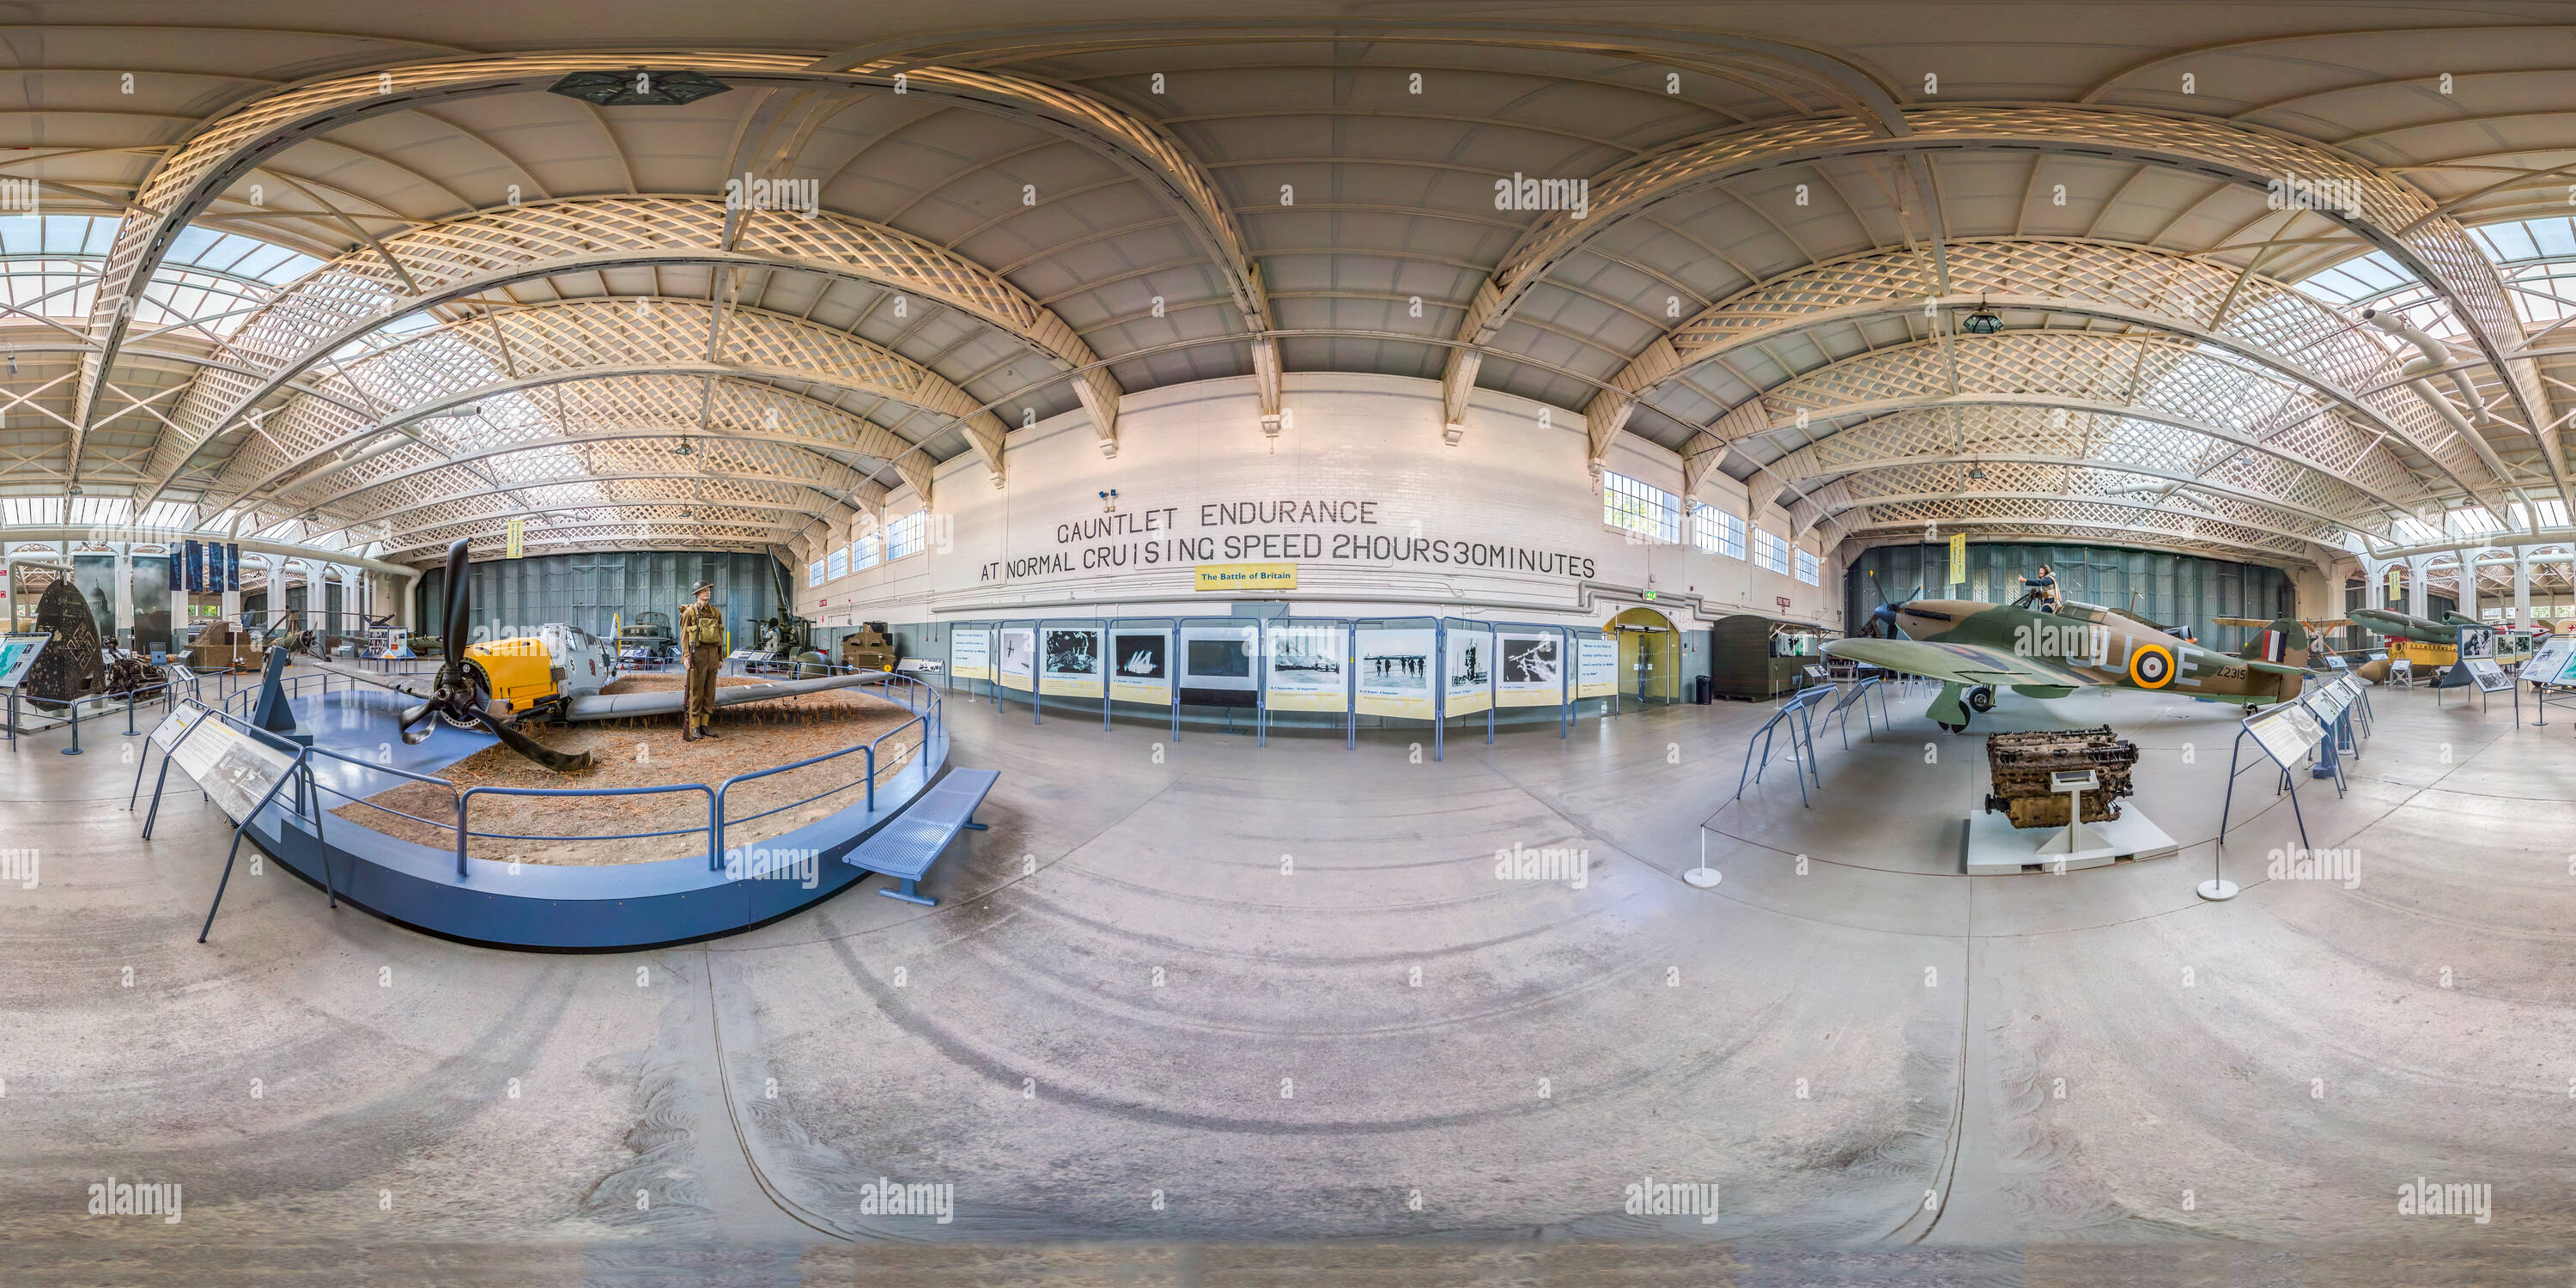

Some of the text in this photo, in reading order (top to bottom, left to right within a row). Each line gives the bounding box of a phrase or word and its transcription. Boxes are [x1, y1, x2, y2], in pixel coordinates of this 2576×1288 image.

[1057, 500, 1378, 544] GAUNTLET ENDURANCE
[981, 562, 999, 581] AT
[1006, 552, 1076, 579] NORMAL
[1083, 537, 1214, 569] CRUISING
[1224, 533, 1321, 559] SPEED
[1220, 572, 1246, 580] Battle
[1249, 572, 1259, 580] of
[1261, 571, 1291, 580] Britain
[2174, 646, 2205, 687] E
[2216, 666, 2246, 680] Z2315
